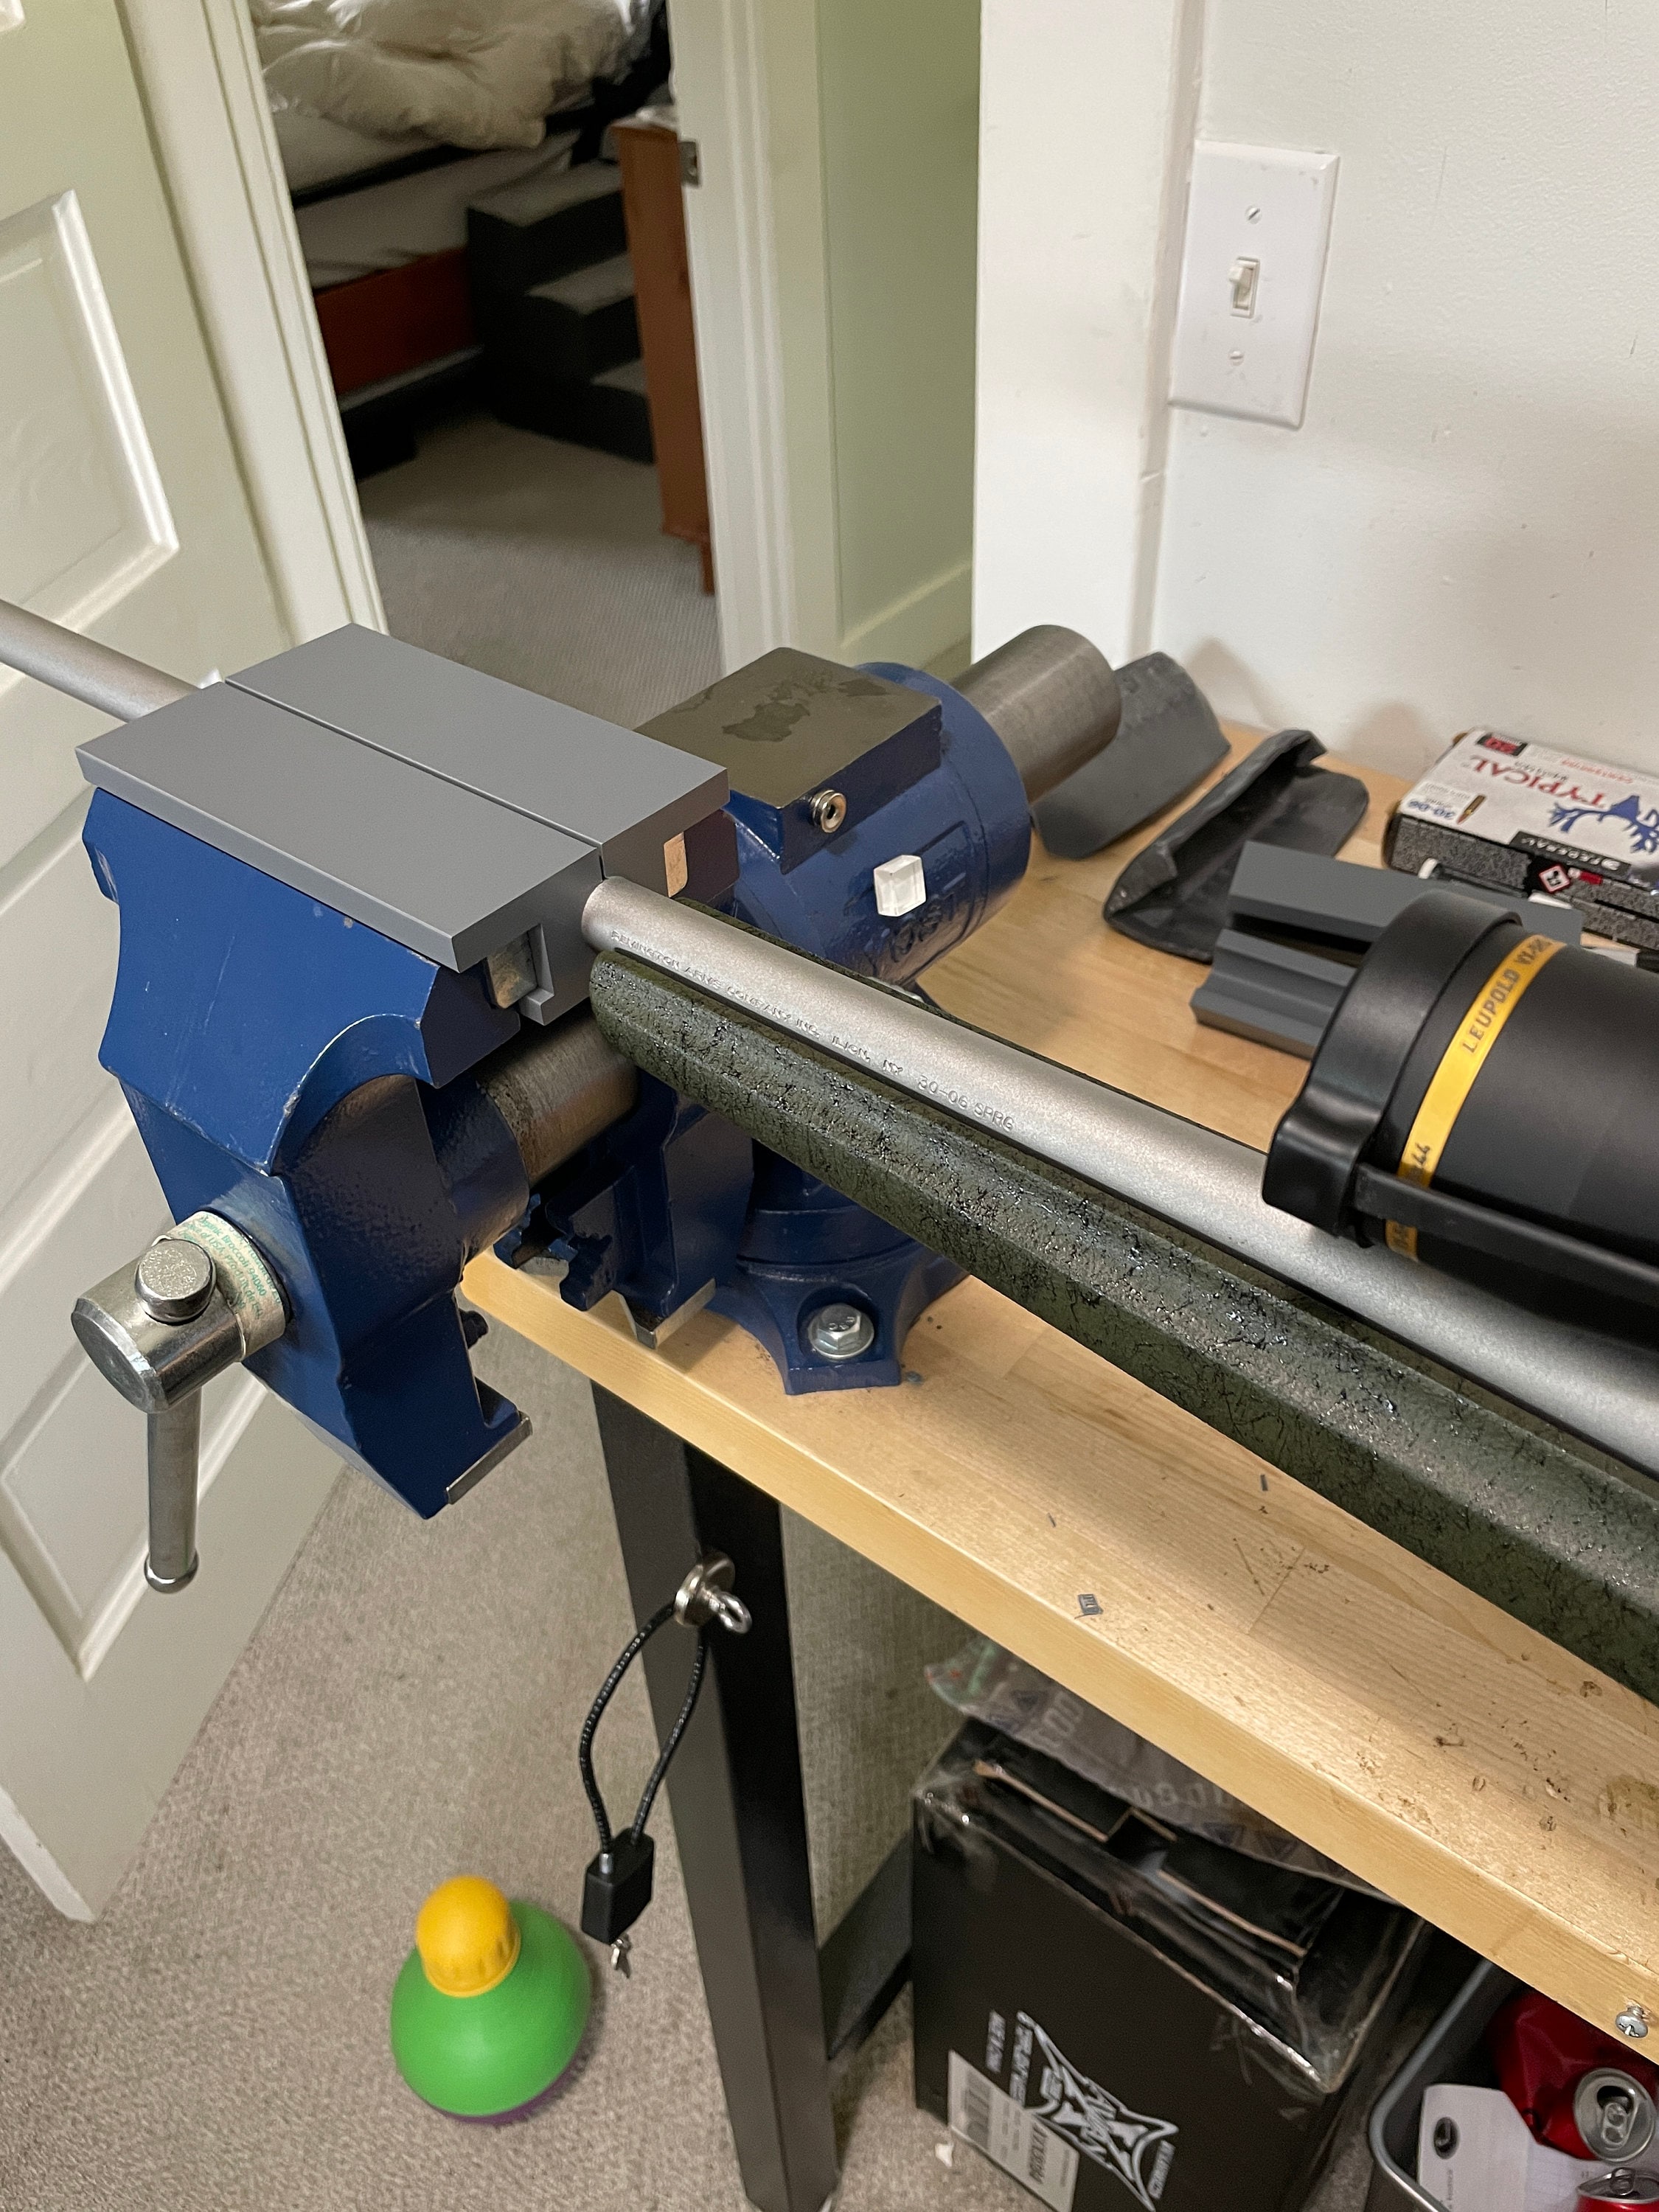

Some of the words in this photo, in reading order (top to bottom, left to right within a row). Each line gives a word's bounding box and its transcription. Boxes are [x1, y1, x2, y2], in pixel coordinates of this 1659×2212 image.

[1470, 755, 1606, 808] TYPICAL
[611, 929, 681, 970] REMINGTON
[684, 966, 722, 990] ARMS
[727, 985, 792, 1021] COMPANY
[883, 1059, 904, 1076] NY
[917, 1075, 970, 1110] 30-06
[973, 1101, 1015, 1133] SPRG
[1462, 970, 1520, 1054] LEUPOLD
[222, 1234, 250, 1268] Broccoli
